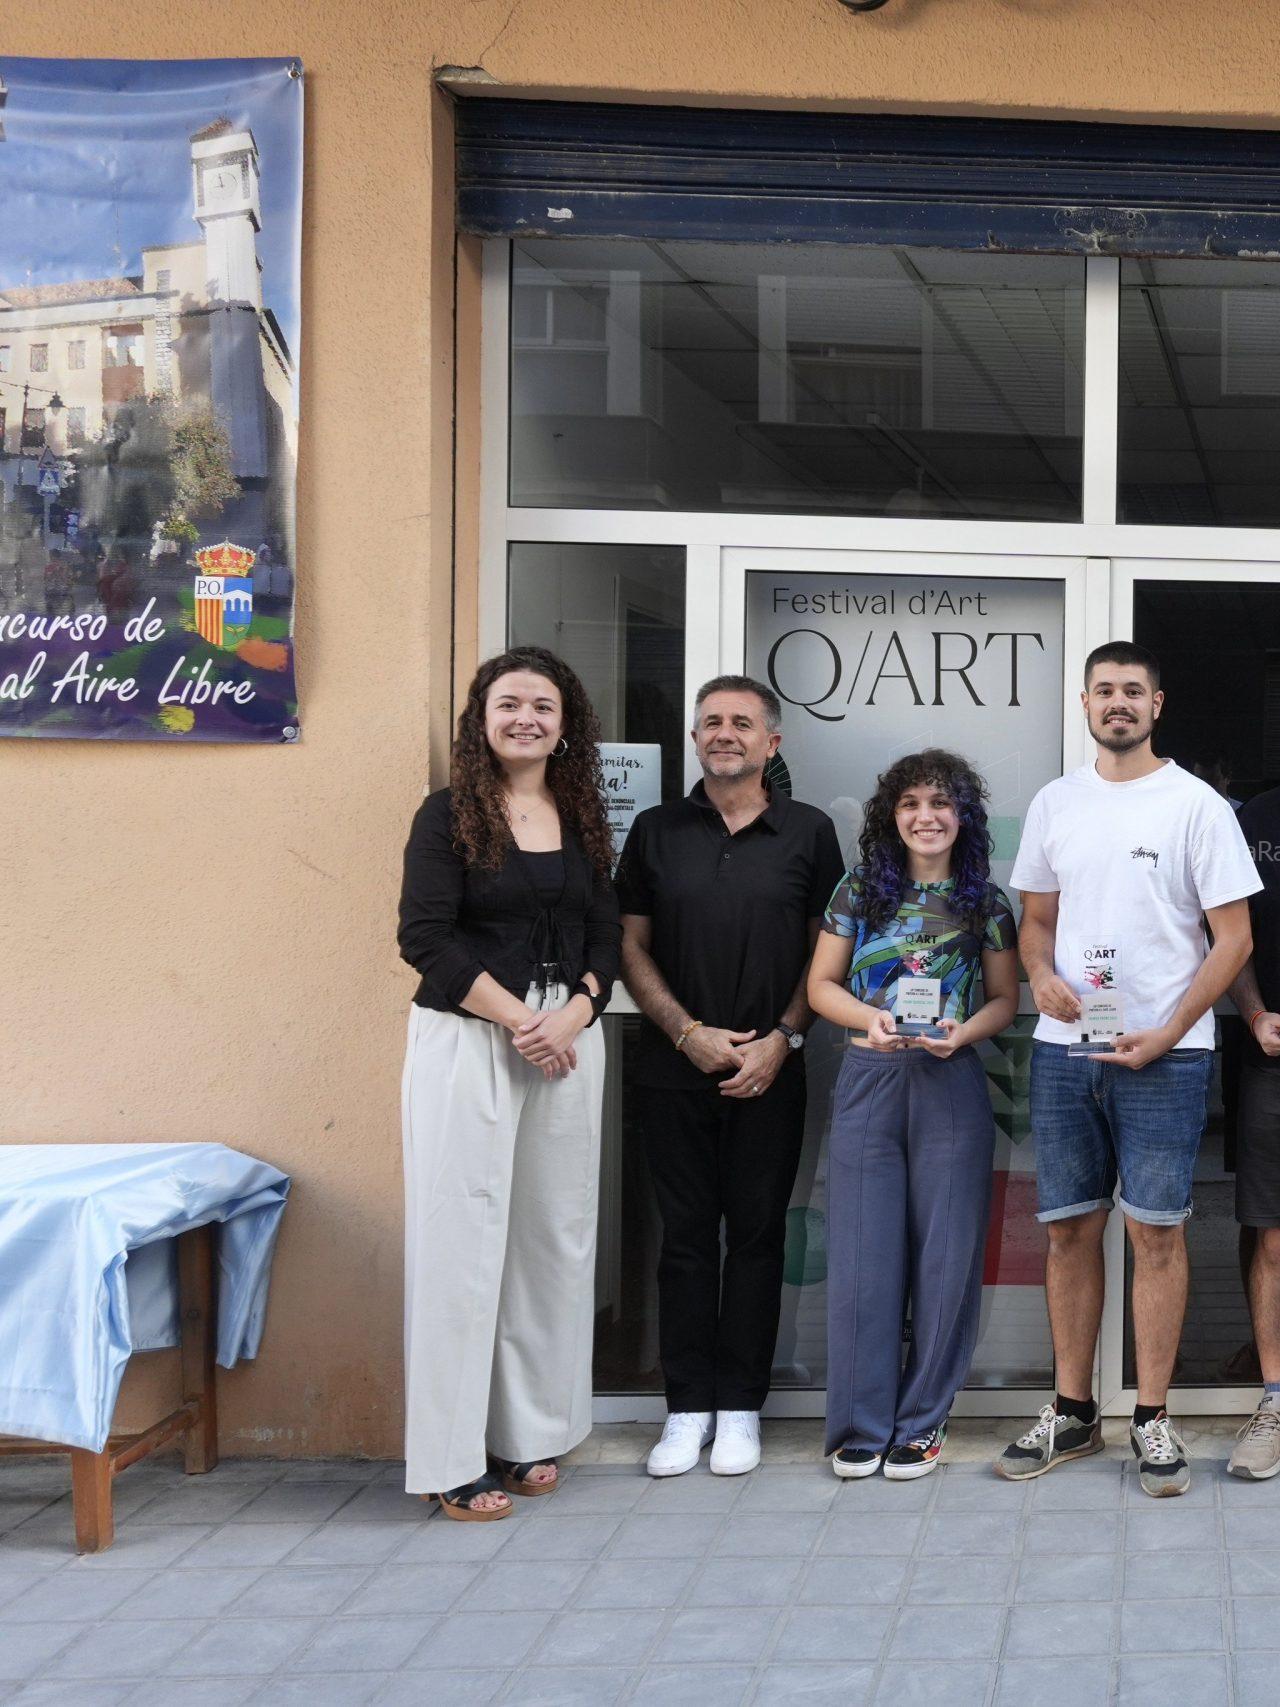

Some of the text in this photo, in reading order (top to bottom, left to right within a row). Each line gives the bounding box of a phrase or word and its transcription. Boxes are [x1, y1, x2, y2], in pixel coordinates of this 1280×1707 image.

[197, 580, 223, 596] P.O.
[772, 588, 895, 615] Festival
[124, 596, 166, 643] de
[0, 650, 257, 706] al Aire Libre
[767, 629, 1045, 722] Q/ART
